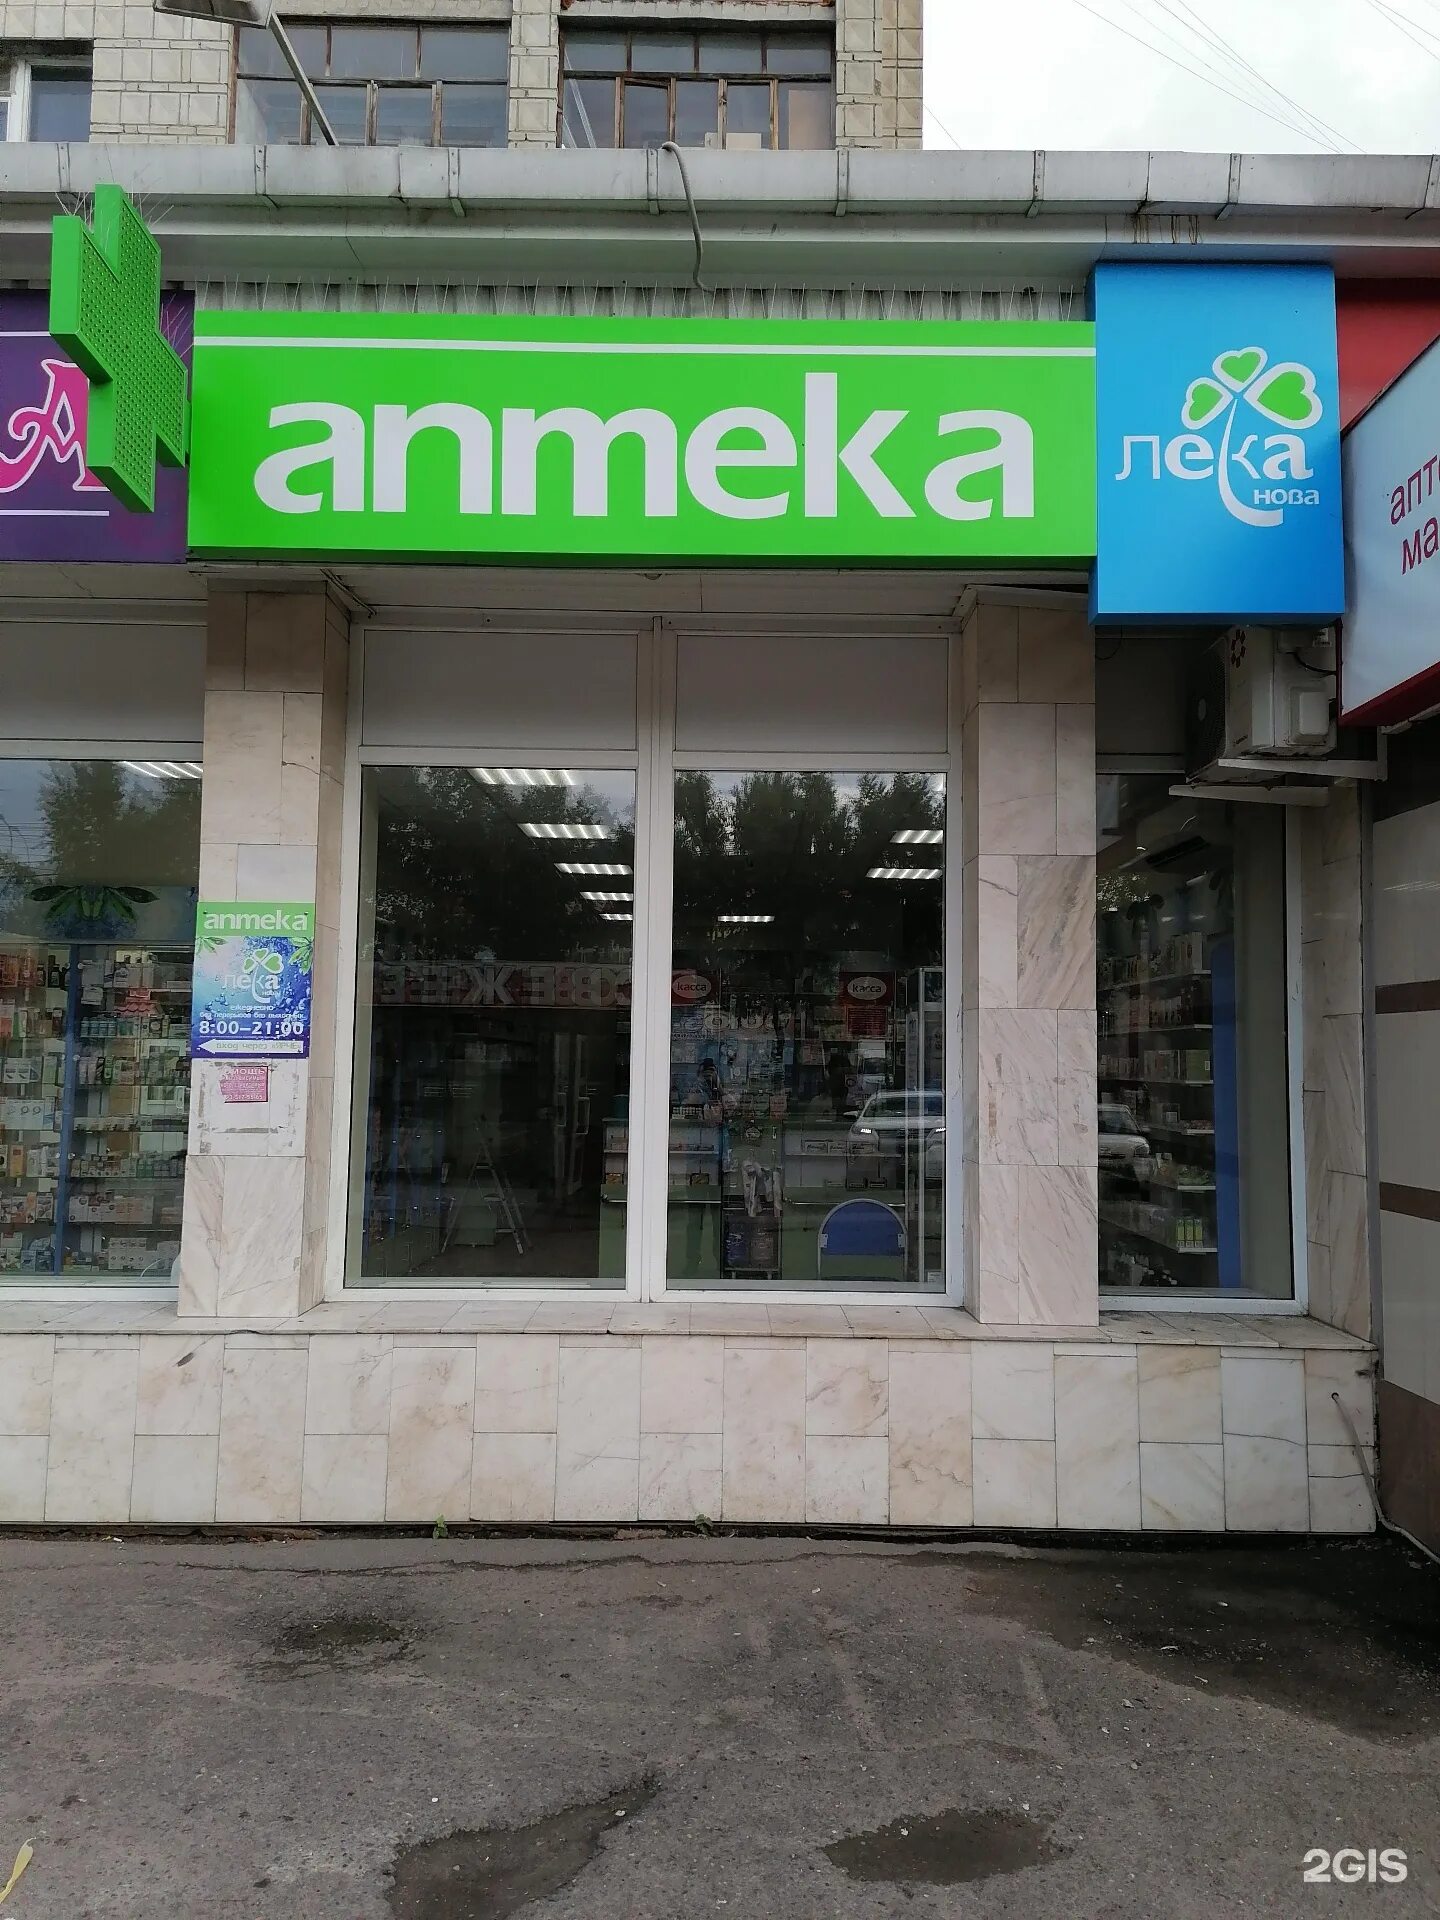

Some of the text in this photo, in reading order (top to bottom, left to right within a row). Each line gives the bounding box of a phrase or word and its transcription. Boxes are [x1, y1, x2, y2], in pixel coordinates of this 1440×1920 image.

[254, 371, 1036, 521] аптека
[1115, 425, 1314, 505] лека
[1253, 488, 1321, 506] нова
[1391, 454, 1440, 525] апт
[203, 909, 308, 931] аптека
[676, 981, 707, 993] касса
[851, 982, 883, 994] касса
